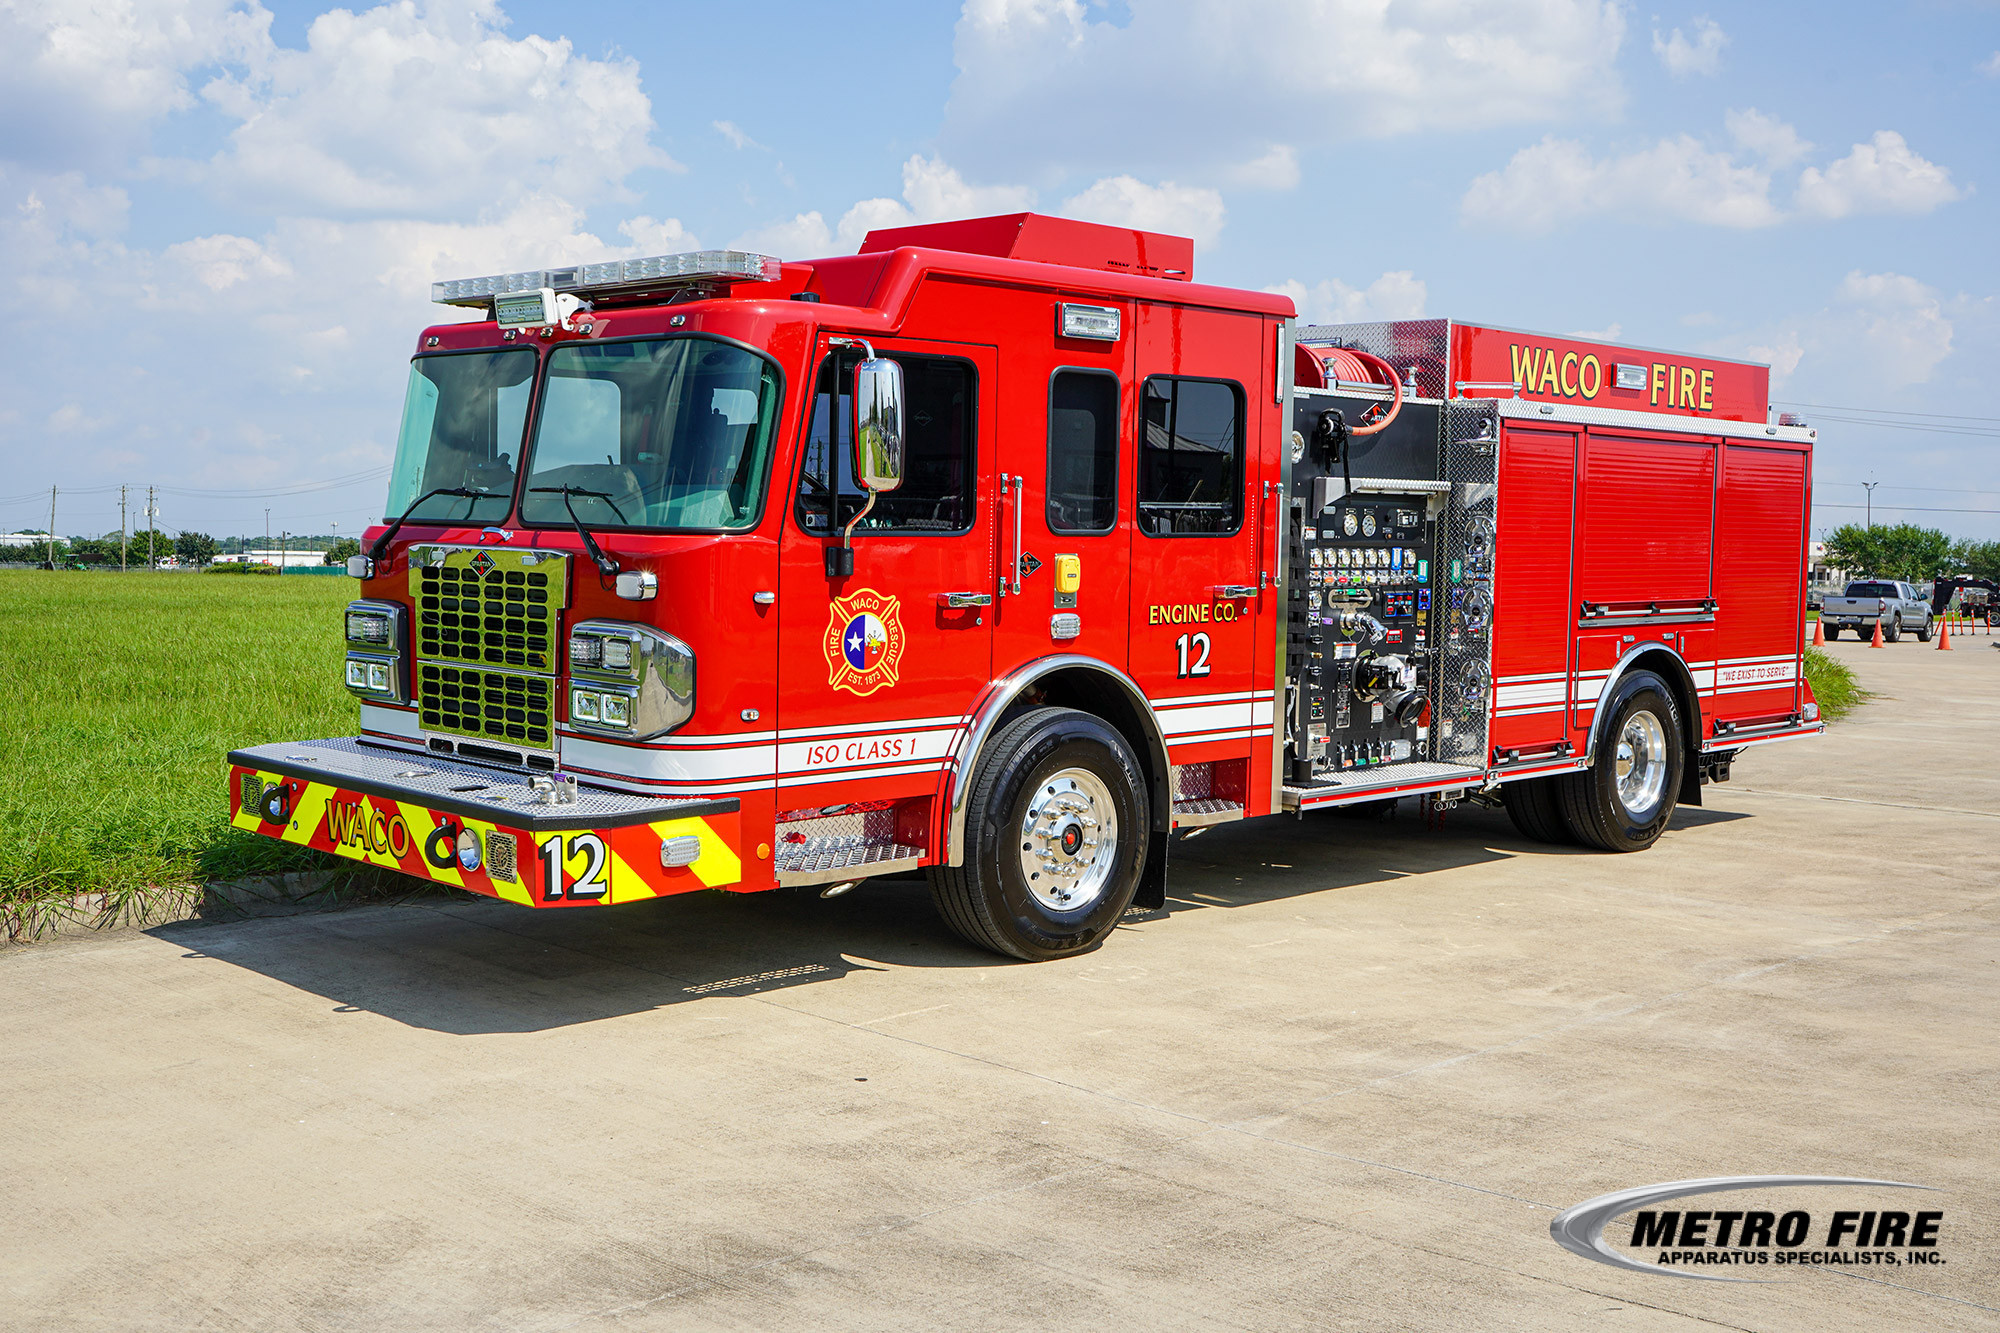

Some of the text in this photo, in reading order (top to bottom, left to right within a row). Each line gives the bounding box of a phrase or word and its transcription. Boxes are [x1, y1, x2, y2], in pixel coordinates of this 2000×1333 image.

[1510, 344, 1714, 412] WACO FIRE
[850, 597, 880, 611] WACO
[1149, 603, 1238, 625] ENGINE CO.
[830, 627, 841, 657] FIRE
[885, 618, 899, 665] RESCUE
[1175, 631, 1211, 679] 12
[847, 670, 881, 686] EST. 1873
[1737, 669, 1755, 680] EXIST
[1757, 668, 1766, 678] TO
[806, 738, 916, 765] ISO CLASS 1
[325, 799, 410, 860] WACO
[539, 833, 607, 901] 12
